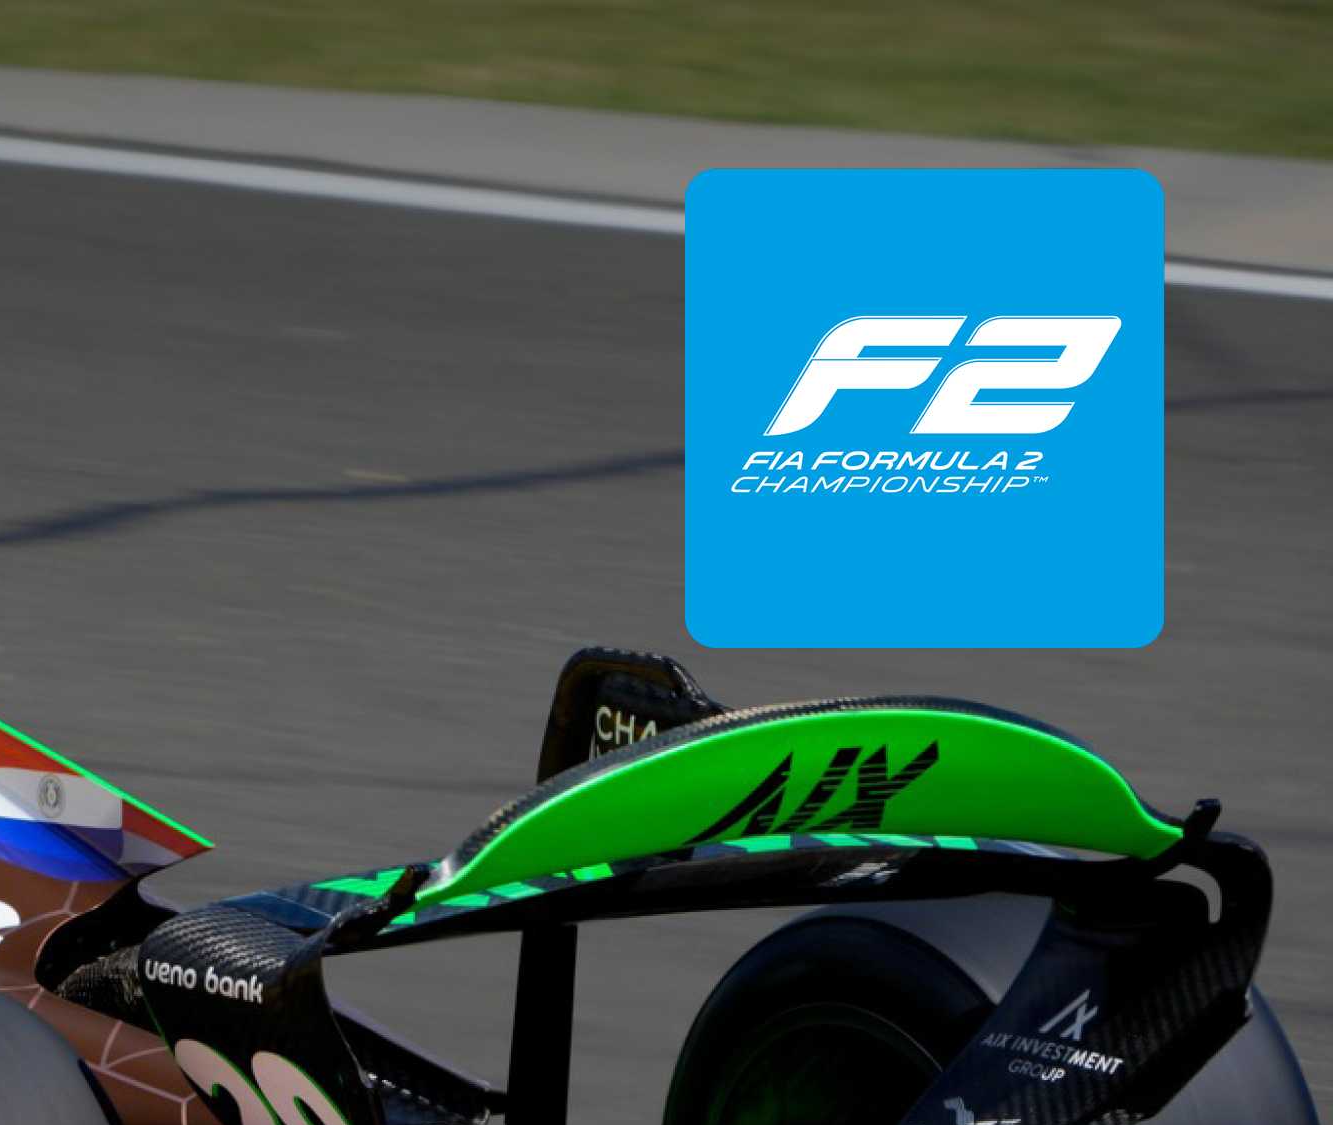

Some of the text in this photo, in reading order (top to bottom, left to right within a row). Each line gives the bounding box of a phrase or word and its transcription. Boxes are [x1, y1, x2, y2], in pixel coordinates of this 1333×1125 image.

[144, 957, 264, 1004] ueno bank
[1010, 1034, 1125, 1076] INVESTMENT
